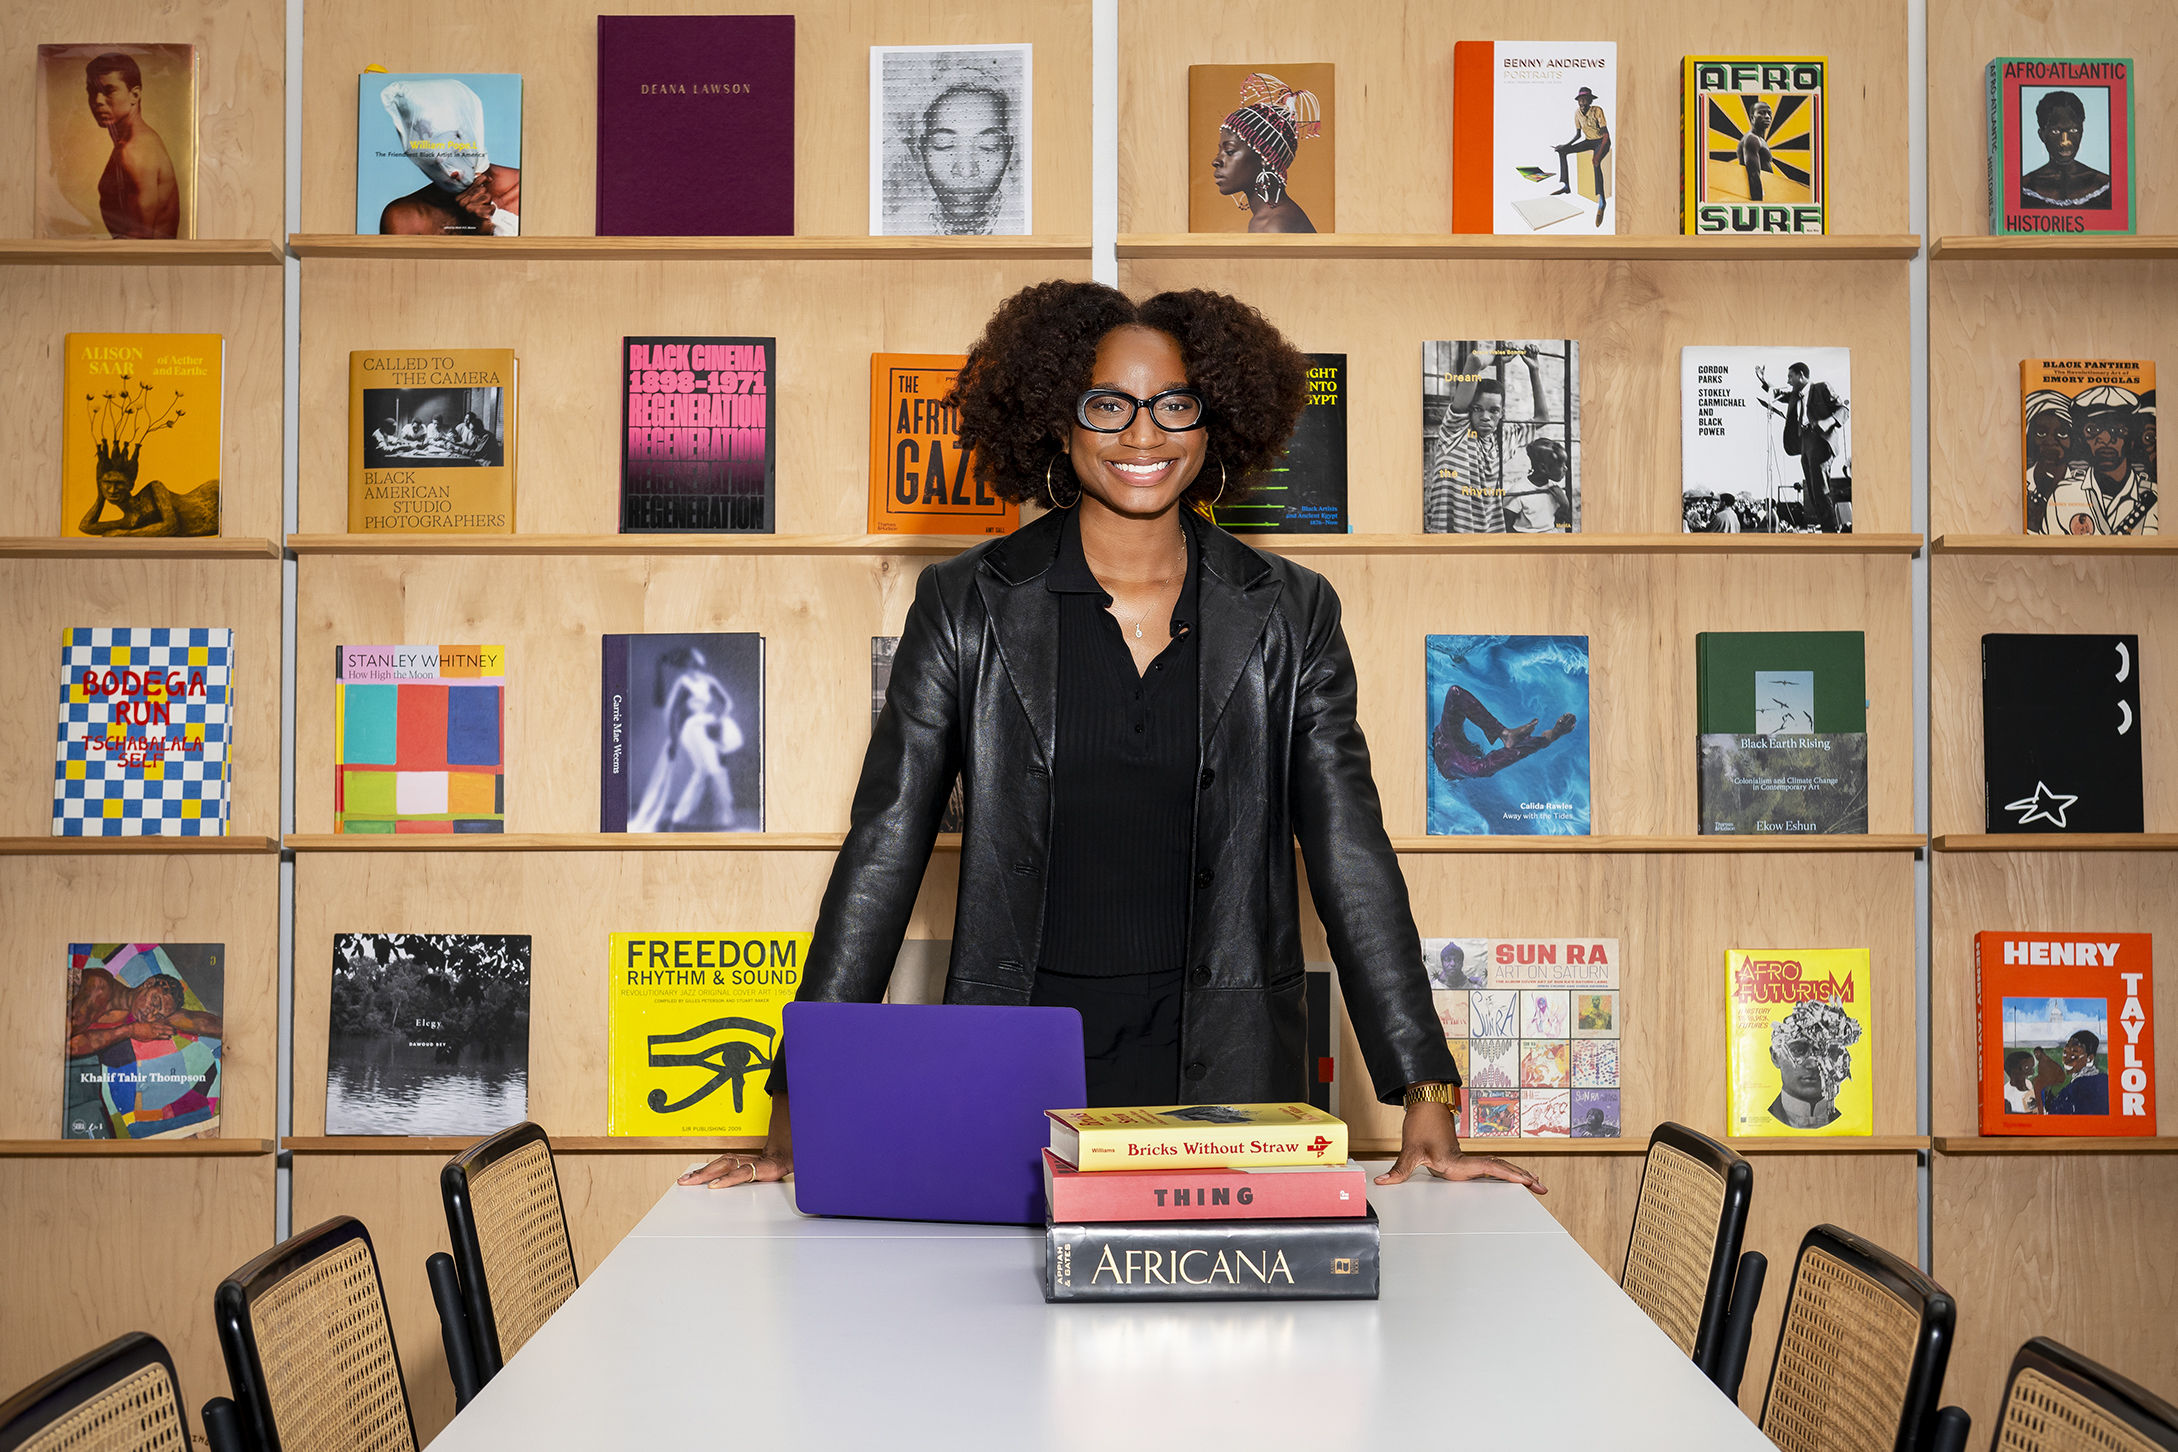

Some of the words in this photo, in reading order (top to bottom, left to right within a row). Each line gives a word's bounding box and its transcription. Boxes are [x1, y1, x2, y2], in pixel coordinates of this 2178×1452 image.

[1503, 58, 1543, 68] BENNY
[1545, 58, 1607, 69] ANDREWS
[1503, 70, 1563, 80] PORTRAITS
[1698, 63, 1821, 92] AFRO
[641, 84, 686, 94] DEANA
[693, 83, 751, 94] LAWSON
[409, 140, 445, 150] William
[1698, 205, 1821, 234] SURF
[2006, 215, 2086, 232] HISTORIES
[81, 347, 143, 361] ALISON
[156, 356, 168, 365] of
[169, 356, 203, 366] Aether
[628, 344, 690, 371] BLACK
[691, 344, 767, 372] CINEMA
[89, 361, 135, 375] SAAR
[153, 366, 172, 376] and
[363, 358, 428, 371] CALLED
[431, 357, 455, 370] TO
[1698, 366, 1729, 374] GORDON
[2042, 361, 2082, 369] BLACK
[2084, 361, 2140, 370] PANTHER
[392, 372, 426, 385] THE
[430, 371, 500, 385] CAMERA
[1444, 372, 1482, 383] Dream
[1698, 375, 1723, 384] PARKS
[2042, 376, 2084, 384] EMORY
[2087, 376, 2140, 384] DOUGLAS
[899, 376, 919, 394] THE
[1308, 381, 1338, 392] NTO
[1698, 388, 1731, 398] STOKELY
[1698, 398, 1746, 407] CARMICHAEL
[628, 393, 767, 428] REGENERATION
[1698, 408, 1714, 416] AND
[1698, 418, 1723, 426] BLACK
[1698, 428, 1726, 436] POWER
[627, 427, 766, 462] REGENERATION
[364, 471, 416, 485] BLACK
[1439, 468, 1458, 479] the
[364, 485, 451, 500] AMERICAN
[1461, 485, 1506, 498] Rhythm
[393, 500, 452, 514] STUDIO
[626, 495, 765, 530] REGENERATION
[364, 514, 506, 529] PHOTOGRAPHERS
[348, 654, 418, 668] STANLEY
[421, 654, 498, 668] WHITNEY
[348, 670, 368, 680] How
[370, 670, 392, 681] High
[393, 670, 407, 679] the
[408, 670, 434, 680] Moon
[82, 670, 207, 697] BODEGA
[115, 700, 171, 726] RUN
[612, 694, 623, 722] Carrie
[612, 726, 623, 744] Mae
[81, 735, 204, 752] TSCHABALALA
[1740, 738, 1768, 750] Black
[1769, 738, 1798, 750] Earth
[1800, 738, 1831, 752] Rising
[116, 752, 165, 769] SELF
[612, 745, 623, 775] Weems
[1734, 777, 1772, 785] Colonialism
[1786, 776, 1812, 784] Climate
[1812, 776, 1839, 786] Change
[1760, 784, 1807, 792] Contemporary
[1520, 802, 1544, 810] Calida
[1546, 802, 1573, 810] Rawles
[1502, 812, 1521, 820] Away
[1522, 812, 1538, 820] with
[1540, 812, 1552, 820] the
[1756, 821, 1784, 831] Ekow
[1785, 821, 1818, 831] Eshun
[627, 939, 797, 969] FREEDOM
[1496, 944, 1557, 965] SUN
[1566, 944, 1609, 965] RA
[2003, 941, 2121, 967] HENRY
[1495, 965, 1522, 979] ART
[1528, 965, 1548, 979] ON
[1552, 965, 1609, 980] SATURN
[1737, 957, 1801, 983] AFRO
[627, 970, 706, 986] RHYTHM
[713, 970, 725, 986] &
[732, 970, 798, 986] SOUND
[620, 989, 678, 997] REVOLUTIONARY
[680, 989, 696, 997] JAZZ
[698, 988, 730, 996] ORIGINAL
[732, 988, 756, 996] COVER
[757, 988, 771, 996] ART
[1737, 974, 1854, 1003] FUTURISM
[416, 1018, 442, 1030] Elegy
[2119, 972, 2147, 1116] TAYLOR
[80, 1072, 117, 1083] Khalif
[118, 1072, 148, 1083] Tahir
[149, 1072, 206, 1085] Thompson
[1128, 1142, 1178, 1156] Bricks
[1183, 1142, 1245, 1156] Without
[1250, 1140, 1300, 1154] Straw
[1154, 1187, 1254, 1207] THING
[1056, 1246, 1064, 1285] APPIAH
[1064, 1243, 1072, 1276] GATES
[1091, 1243, 1295, 1285] AFRICANA
[1064, 1279, 1071, 1288] &
